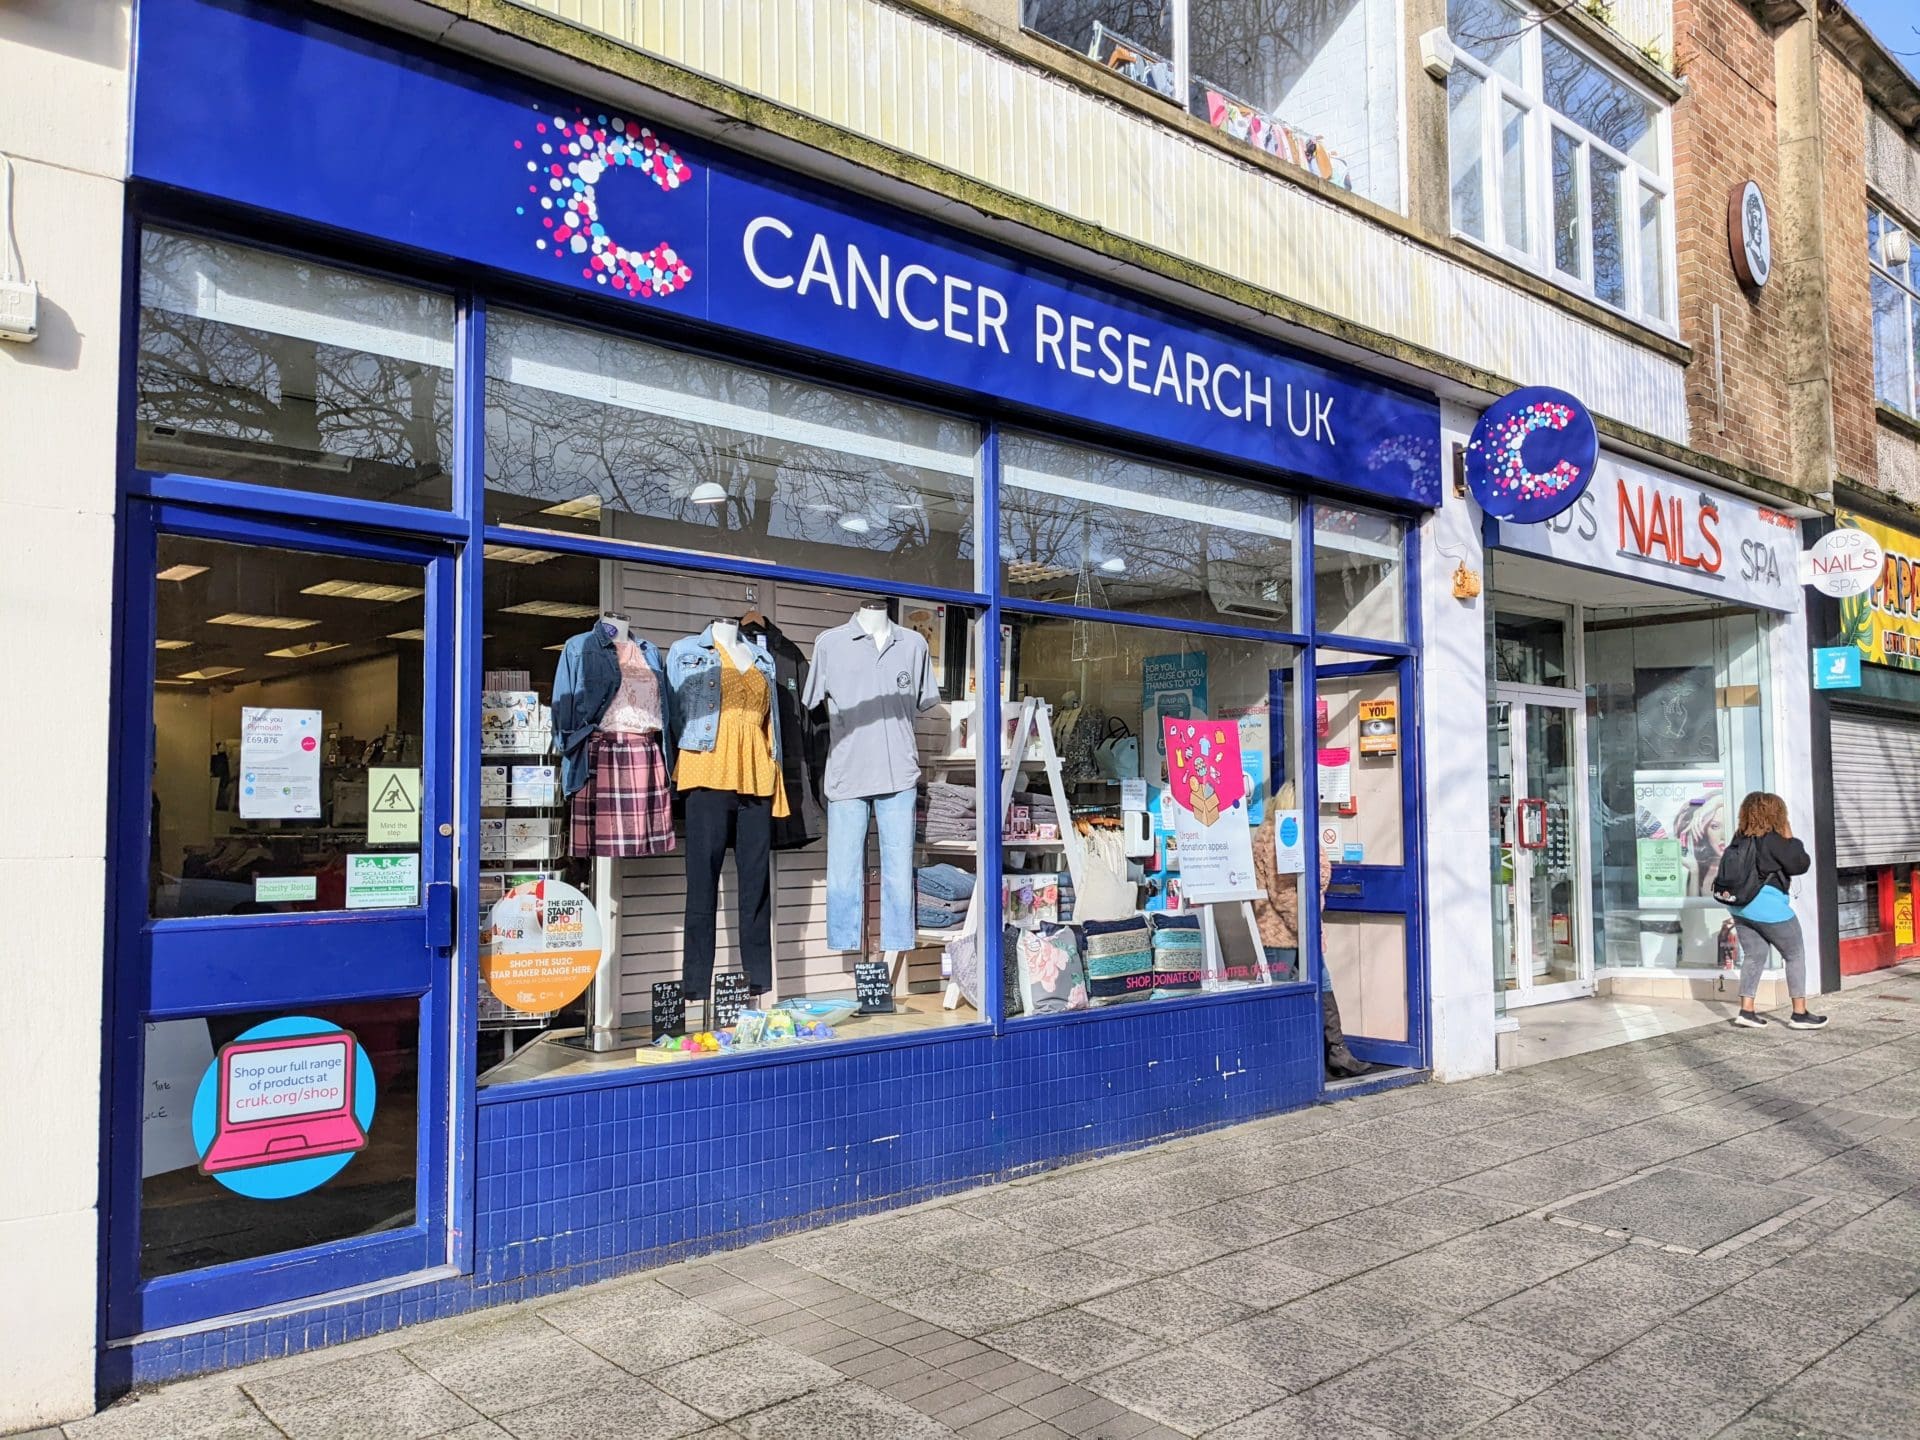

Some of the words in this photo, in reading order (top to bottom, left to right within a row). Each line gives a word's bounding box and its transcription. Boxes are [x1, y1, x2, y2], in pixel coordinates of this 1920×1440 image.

[743, 216, 1010, 354] CANCER
[1036, 304, 1272, 427] RESEARCH
[1287, 383, 1335, 446] UK
[1617, 479, 1723, 573] NAILS
[1740, 538, 1782, 587] SPA
[1825, 533, 1861, 549] KD'S
[1812, 551, 1878, 575] NAILS
[1828, 578, 1861, 593] SPA
[1882, 630, 1907, 655] LATIN
[1145, 664, 1160, 673] FOR
[1145, 671, 1175, 681] BECAUSE
[1176, 670, 1186, 678] OF
[1145, 680, 1173, 689] THANKS
[1174, 679, 1185, 688] TO
[1186, 678, 1201, 687] YOU
[1369, 707, 1387, 717] YOU
[248, 714, 269, 722] Thank
[247, 723, 282, 732] Plymouth
[246, 736, 279, 745] £69,876
[1635, 784, 1687, 801] gelcolor
[1179, 831, 1200, 841] Urgent
[1180, 843, 1207, 851] donation
[1208, 842, 1229, 852] appeal
[355, 857, 412, 868] P.A.R.C.
[258, 884, 288, 892] Charity
[290, 883, 312, 891] Retail
[547, 907, 575, 916] STAND
[546, 923, 583, 933] CANCER
[510, 959, 534, 968] SHOP
[535, 958, 550, 967] THE
[551, 957, 573, 966] SU2C
[490, 970, 511, 979] STAR
[512, 968, 539, 977] BAKER
[541, 966, 570, 976] RANGE
[572, 965, 592, 973] HERE
[1152, 971, 1188, 987] DONATE
[1188, 970, 1200, 983] OR
[234, 1066, 265, 1078] Shop
[267, 1064, 287, 1074] our
[290, 1060, 308, 1071] full
[310, 1058, 342, 1070] range
[248, 1079, 262, 1091] of
[263, 1074, 315, 1091] products
[316, 1072, 327, 1083] at
[235, 1086, 339, 1109] cruk.org/shop
